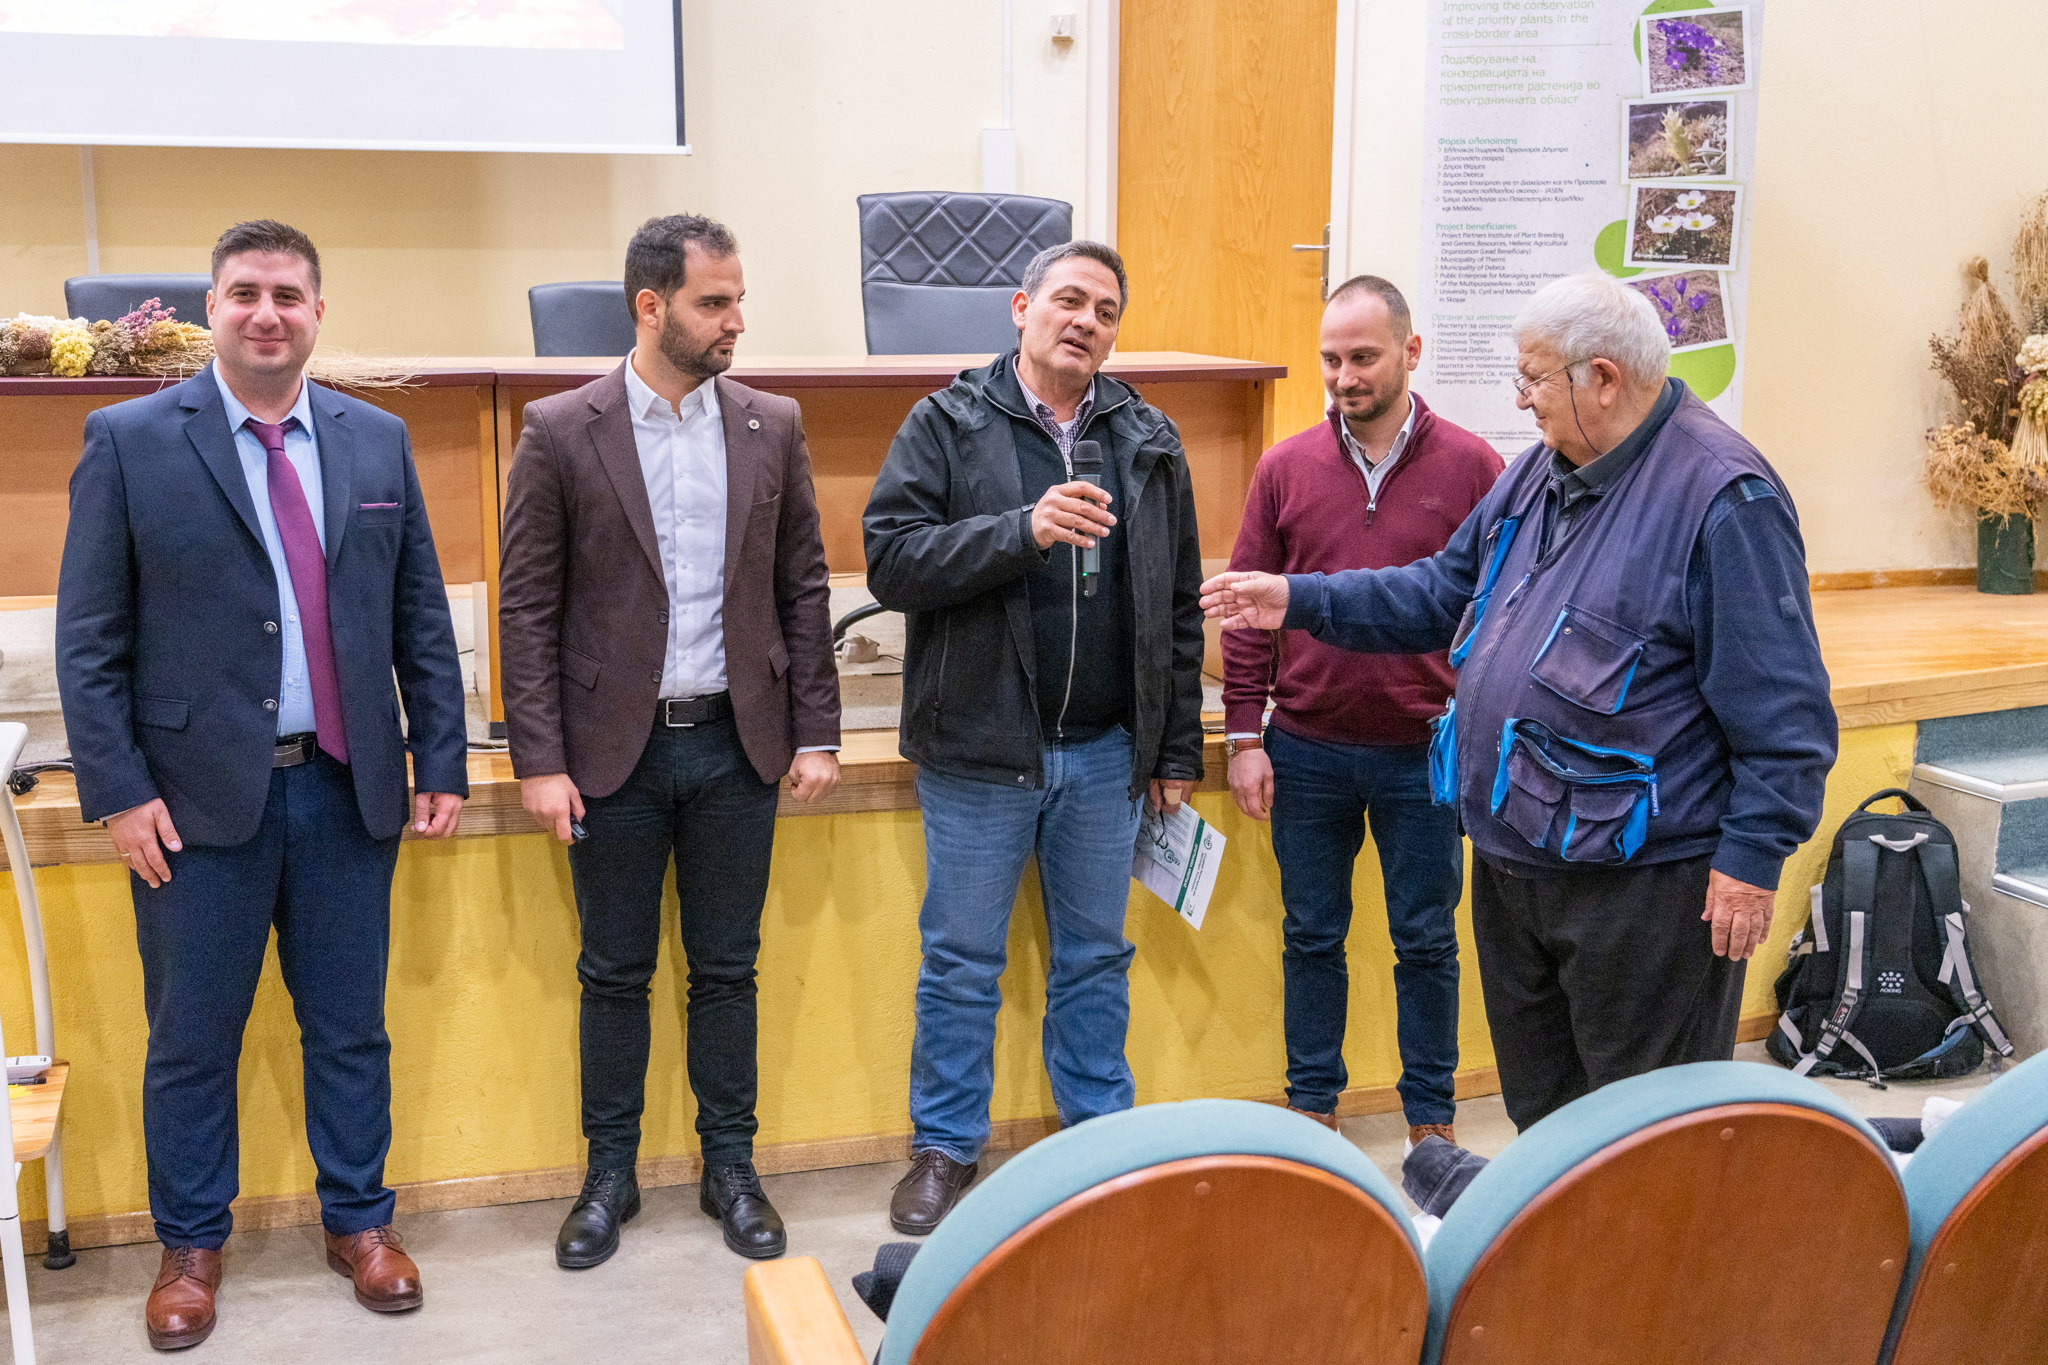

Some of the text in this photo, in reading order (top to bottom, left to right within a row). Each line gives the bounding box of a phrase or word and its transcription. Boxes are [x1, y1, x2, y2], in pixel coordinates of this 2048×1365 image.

[1443, 1, 1594, 13] Improving the conservation
[1442, 14, 1589, 26] of the priority plants in the
[1442, 29, 1539, 39] cross-border area
[1441, 54, 1536, 66] Подобрување на
[1440, 69, 1546, 79] конзервацијата на
[1440, 81, 1600, 94] приоритетните растенија во
[1440, 94, 1579, 107] прекуграничната област
[1435, 222, 1517, 232] Project beneficiaries
[1538, 232, 1565, 240] Breeding
[1533, 240, 1568, 248] Agricultural
[1440, 256, 1476, 264] Municipality
[1440, 264, 1476, 272] Municipality
[1499, 272, 1529, 280] Managing
[1439, 288, 1469, 296] University
[1478, 288, 1492, 296] Cyril
[1446, 296, 1466, 304] Skopje
[1431, 313, 1463, 322] Органи
